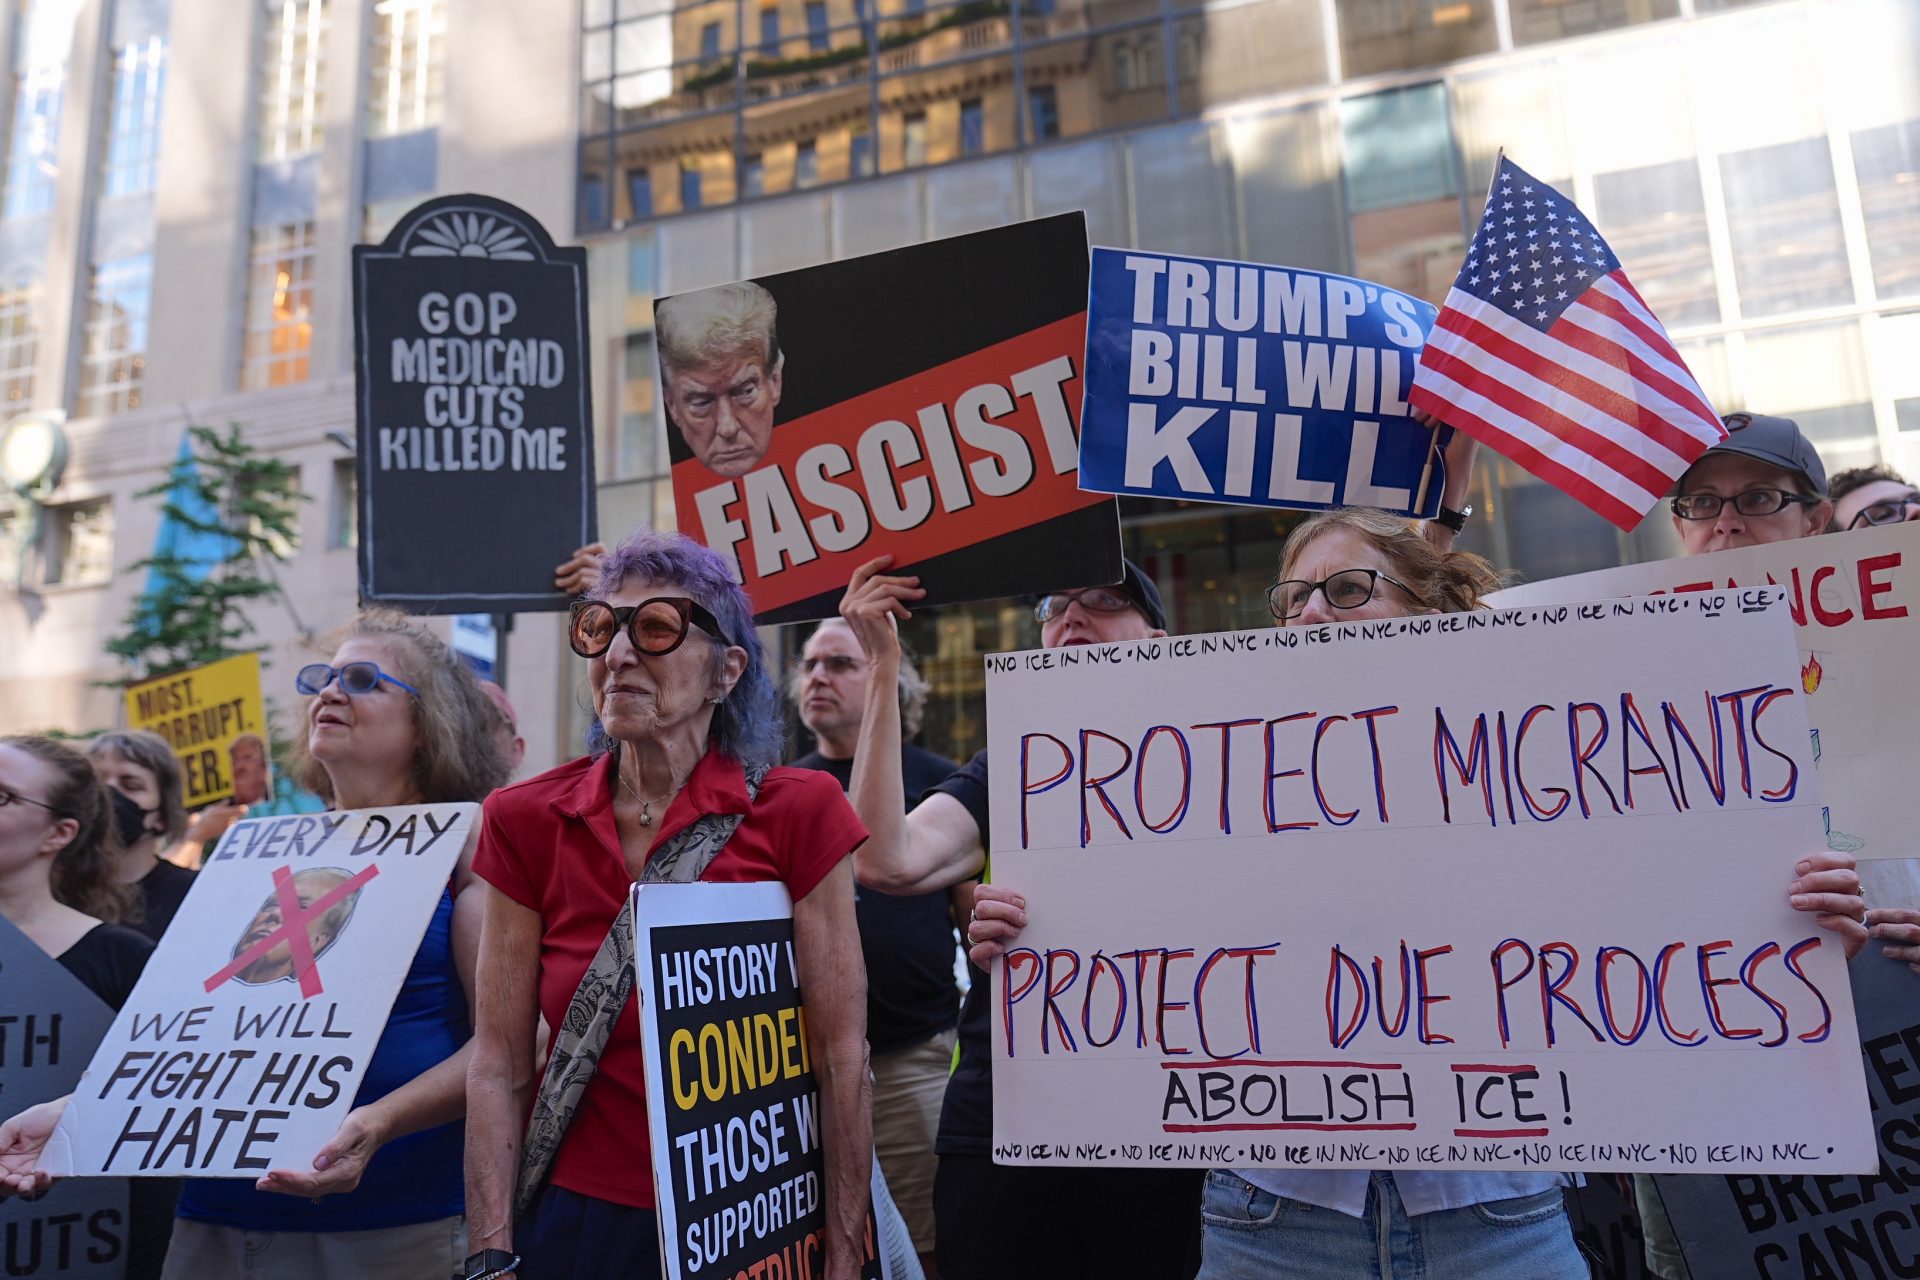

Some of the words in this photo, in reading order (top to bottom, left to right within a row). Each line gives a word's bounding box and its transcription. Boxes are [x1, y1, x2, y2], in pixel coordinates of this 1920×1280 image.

[418, 291, 517, 336] GOP
[1125, 255, 1426, 348] TRUMP'S
[391, 338, 565, 389] MEDICAID
[1129, 329, 1266, 404] BILL
[1283, 340, 1421, 418] WIL
[424, 385, 525, 430] CUTS
[379, 426, 505, 472] KILLED
[510, 427, 567, 471] ME
[694, 355, 1080, 587] FASCIST
[1124, 402, 1411, 511] KILL
[994, 656, 1017, 673] NO
[1026, 652, 1055, 671] ICE
[1060, 650, 1079, 667] IN
[1136, 644, 1161, 663] NO
[1169, 639, 1198, 659] ICE
[1202, 636, 1218, 654] IN
[1274, 629, 1299, 648] NO
[1305, 625, 1332, 645] ICE
[1337, 623, 1358, 641] IN
[1409, 617, 1431, 636] NO
[1438, 614, 1464, 633] ICE
[1467, 613, 1486, 630] IN
[1543, 606, 1568, 626] NO
[1577, 602, 1605, 621] ICE
[1613, 600, 1635, 617] IN
[1700, 595, 1725, 612] NO
[1737, 590, 1771, 609] ICE
[145, 698, 253, 750] ORRUPT.
[1020, 705, 1399, 849] PROTECT
[1434, 683, 1798, 827] MIGRANTS
[216, 813, 349, 861] EVERY
[351, 811, 461, 857] DAY
[660, 942, 778, 1010] HISTORY
[1002, 942, 1281, 1060] PROTECT
[1325, 938, 1455, 1050] DUE
[1490, 936, 1832, 1049] PROCESS
[130, 1005, 214, 1042] WE
[233, 1002, 353, 1041] WILL
[99, 1049, 256, 1101] FIGHT
[247, 1052, 354, 1110] HIS
[669, 1005, 811, 1111] CONDE
[1162, 1070, 1415, 1123] ABOLISH
[102, 1106, 290, 1172] HATE
[676, 1101, 789, 1203] THOSE
[1001, 1143, 1022, 1160] NO
[1026, 1143, 1052, 1160] ICE
[1055, 1143, 1071, 1160] IN
[1122, 1144, 1143, 1160] NO
[1149, 1143, 1174, 1161] ICE
[1178, 1144, 1196, 1160] IN
[1250, 1143, 1276, 1162] NO
[1284, 1144, 1312, 1164] ICE
[1316, 1143, 1335, 1161] IN
[1388, 1143, 1410, 1164] NO
[1416, 1145, 1445, 1162] ICE
[1448, 1144, 1468, 1162] IN
[1522, 1143, 1551, 1165] NO
[1559, 1145, 1587, 1161] ICE
[1591, 1144, 1614, 1162] IN
[1670, 1143, 1697, 1165] NO
[1707, 1144, 1739, 1163] ICE
[1741, 1144, 1763, 1163] IN
[1725, 1114, 1920, 1234] BREAS
[4, 1208, 122, 1277] UTS
[686, 1170, 819, 1273] SUPPORTED
[1753, 1204, 1920, 1280] CANC
